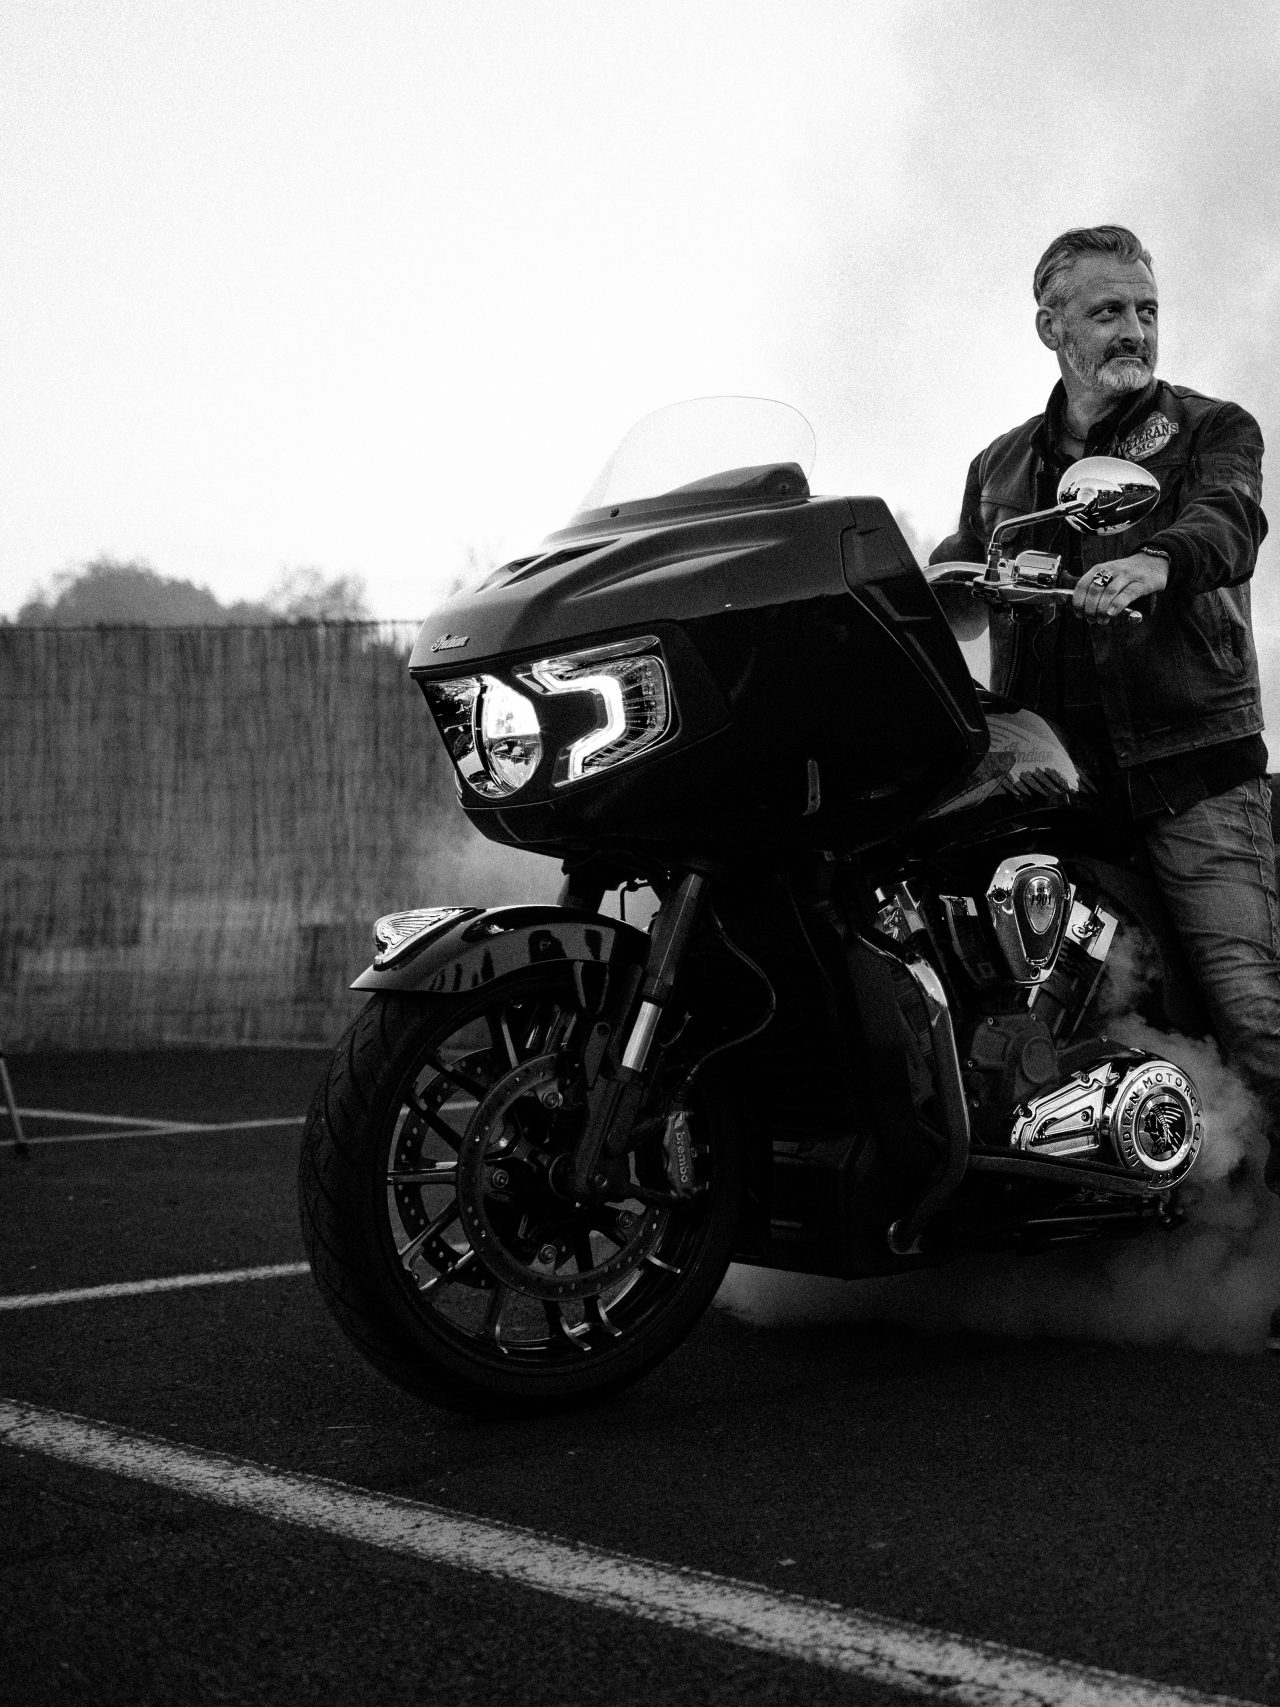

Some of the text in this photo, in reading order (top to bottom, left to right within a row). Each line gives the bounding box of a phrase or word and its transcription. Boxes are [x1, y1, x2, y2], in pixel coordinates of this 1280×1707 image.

[1031, 893, 1051, 905] 1901
[1122, 1073, 1201, 1167] INDIAN MOTORCYCLE
[676, 1131, 688, 1182] brembo
